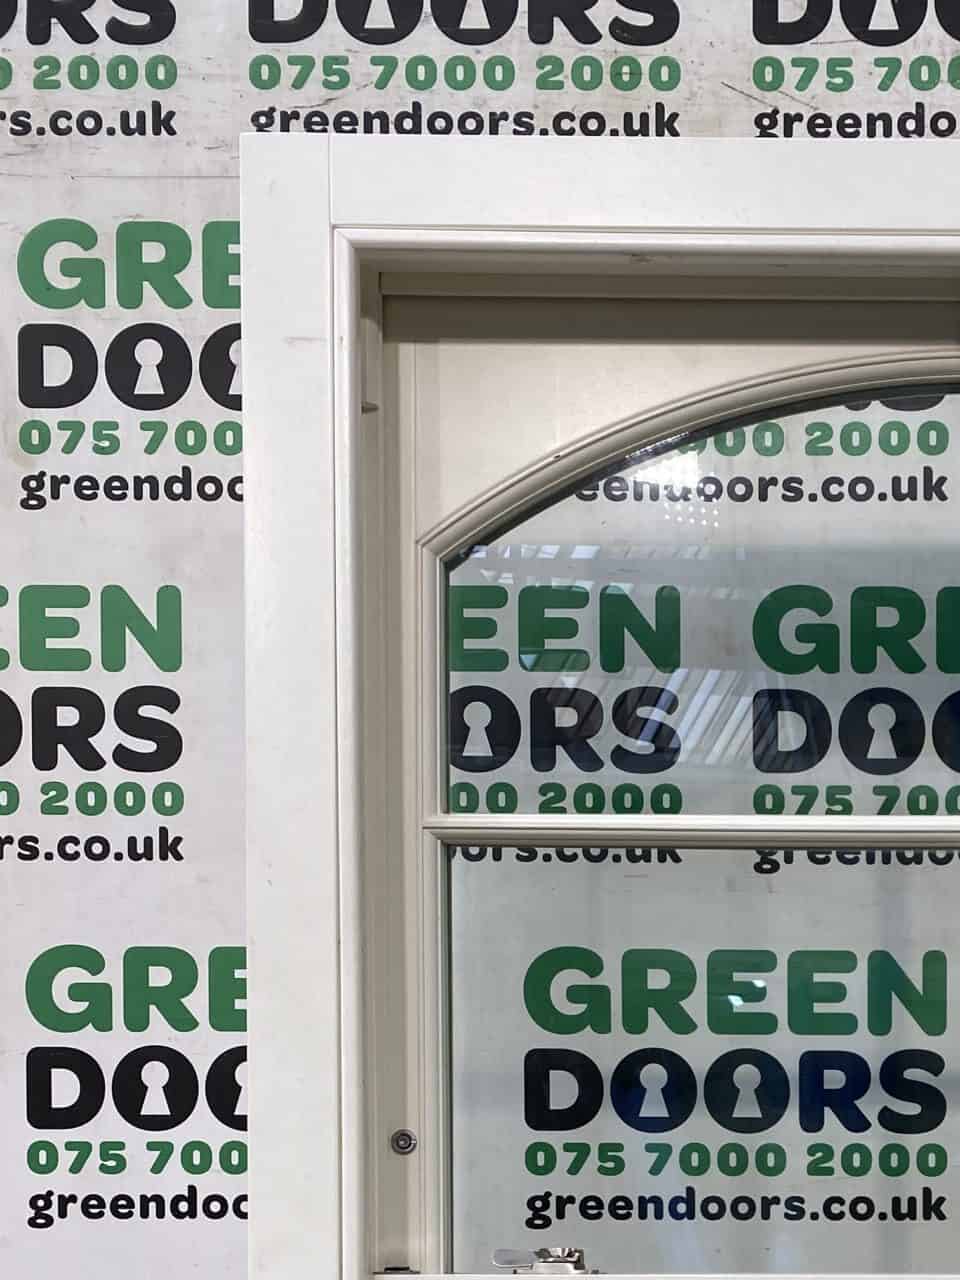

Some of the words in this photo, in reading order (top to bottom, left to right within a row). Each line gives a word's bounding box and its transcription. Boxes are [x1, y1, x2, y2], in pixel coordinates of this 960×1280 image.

[0, 0, 176, 45] RS
[33, 54, 178, 90] 2000
[249, 55, 350, 90] 075
[369, 55, 515, 90] 7000
[535, 55, 681, 90] 2000
[752, 55, 854, 93] 075
[0, 100, 177, 136] s.co.uk
[250, 101, 680, 136] greendoors.co.uk
[19, 420, 120, 455] 075
[804, 421, 949, 456] 2000
[0, 584, 183, 672] EN
[0, 685, 183, 773] RS
[40, 781, 184, 816] 2000
[538, 783, 682, 815] 2000
[753, 785, 853, 815] 075
[523, 946, 947, 1036] GREEN
[524, 1047, 947, 1134] DOORS
[27, 1140, 127, 1175] 075
[525, 1142, 625, 1176] 075
[644, 1142, 787, 1177] 7000
[807, 1143, 948, 1177] 2000
[525, 1186, 947, 1230] greendoors.co.uk
